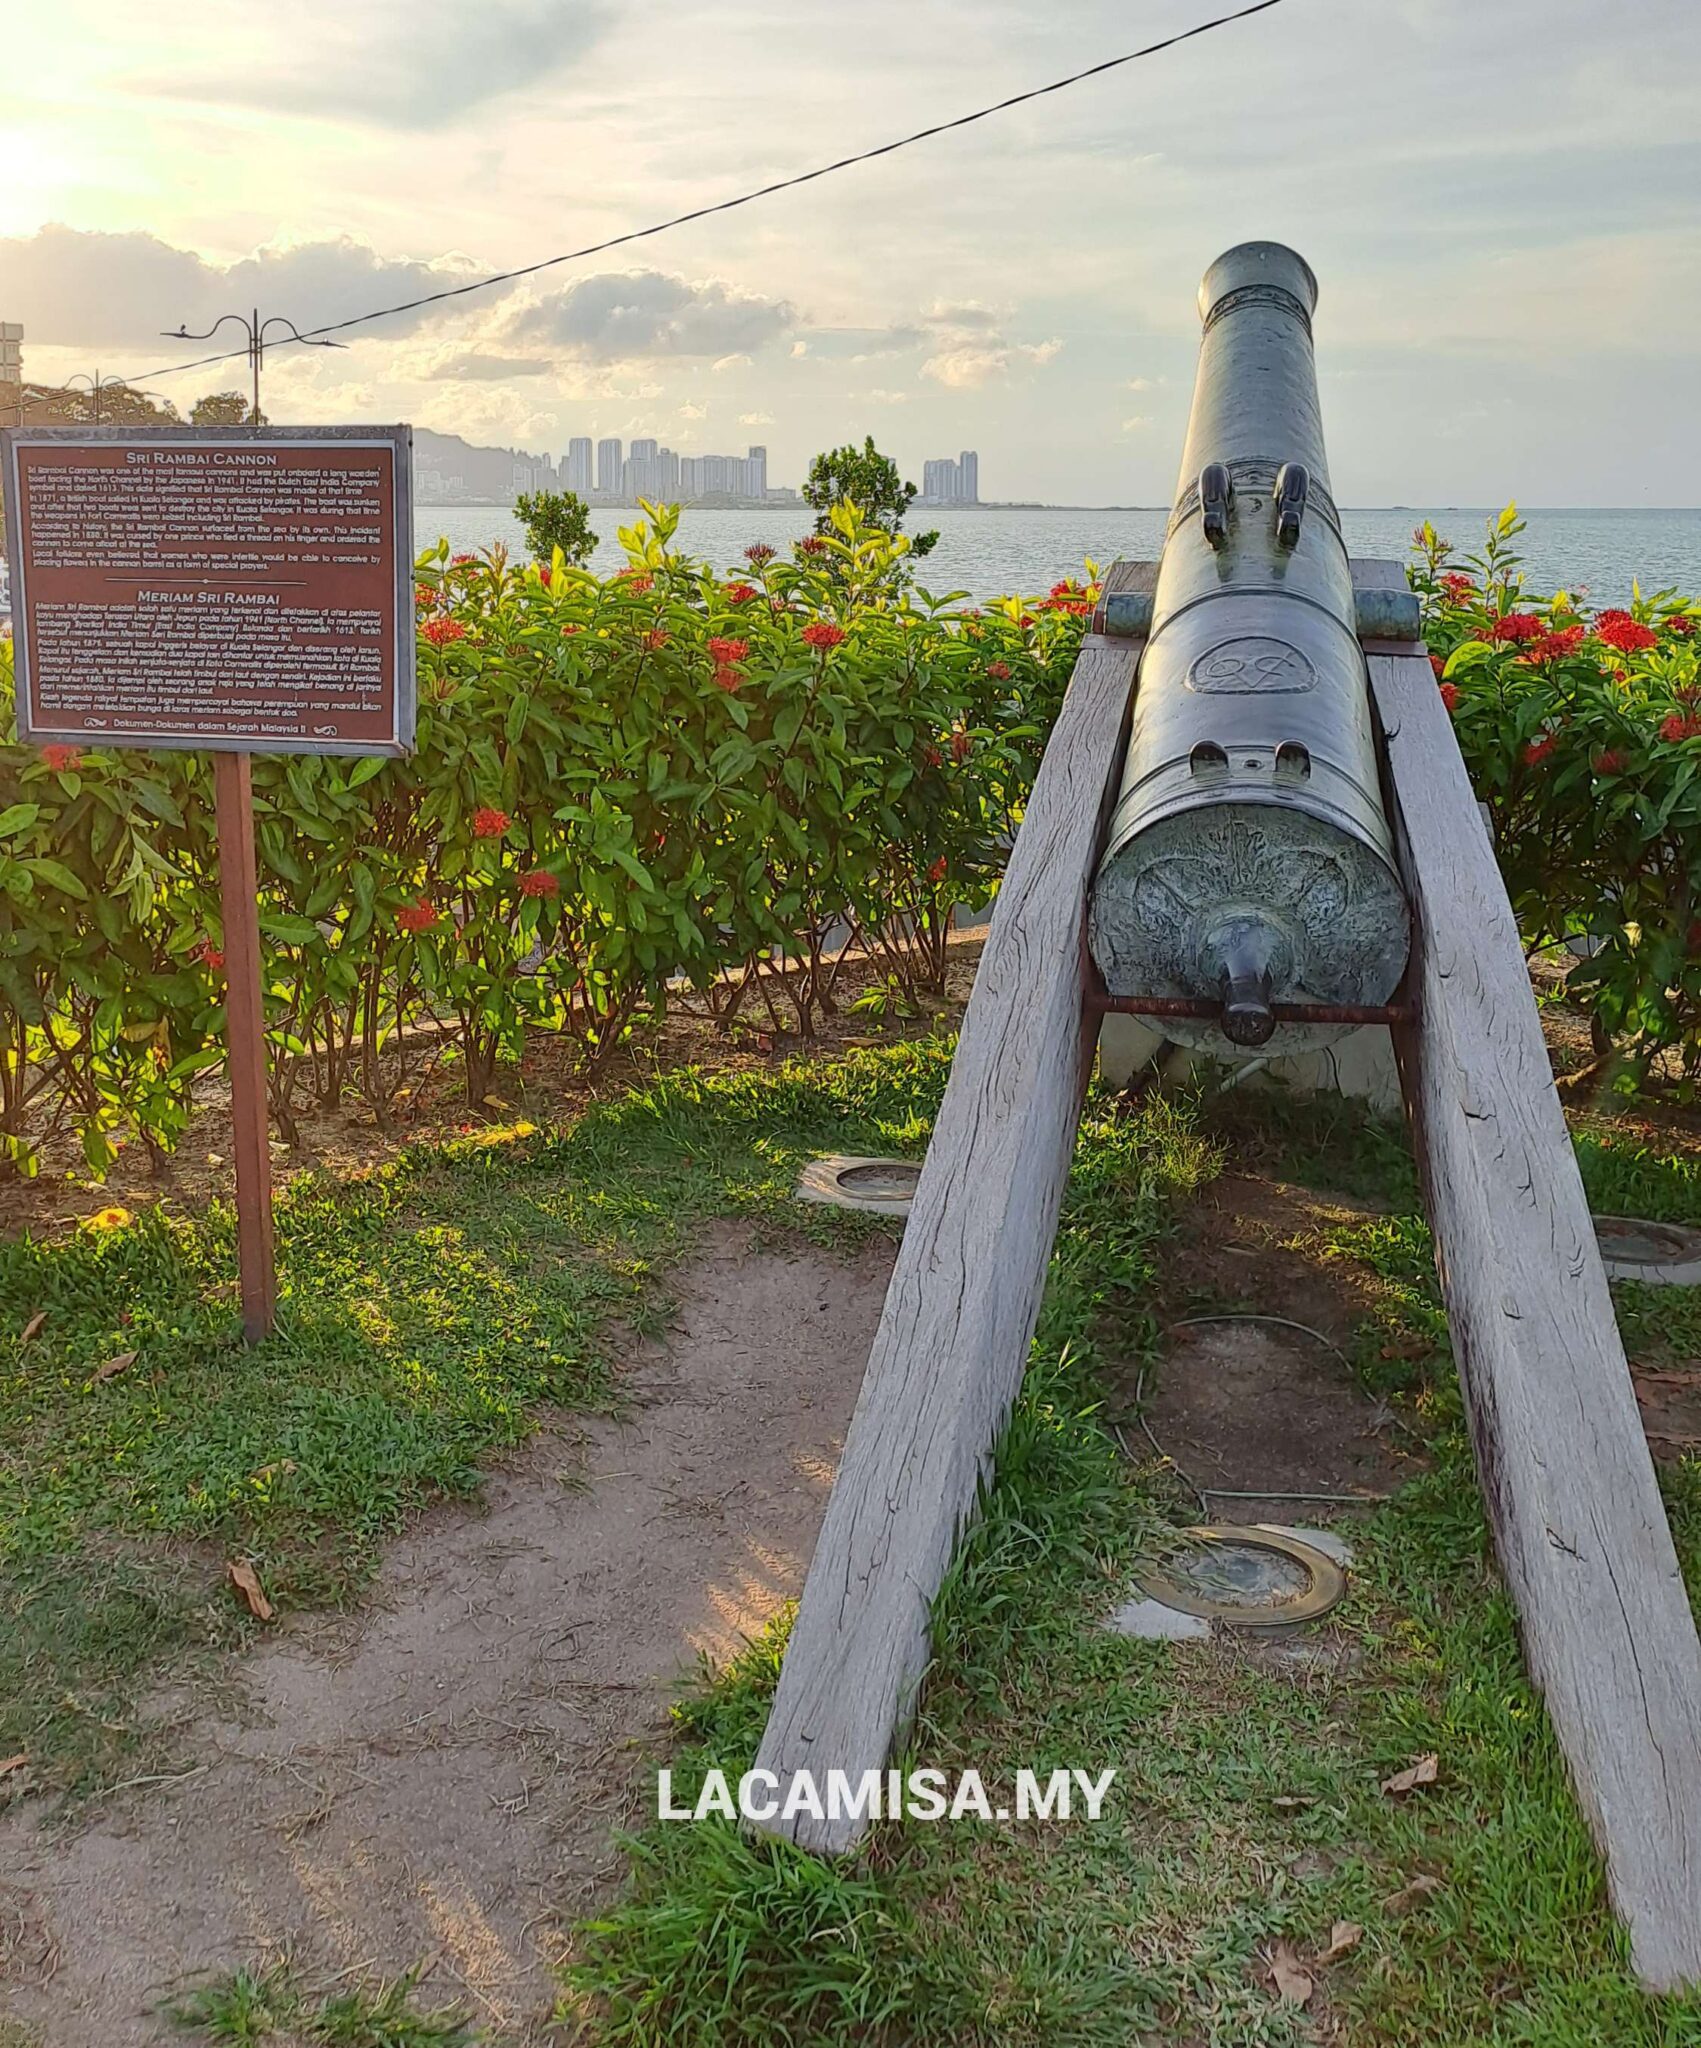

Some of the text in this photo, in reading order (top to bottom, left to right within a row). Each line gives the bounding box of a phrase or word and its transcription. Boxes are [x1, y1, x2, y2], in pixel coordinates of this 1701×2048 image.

[341, 477, 381, 487] Company
[113, 719, 195, 728] Dokumen-Dokumen
[197, 721, 224, 729] dalam
[227, 722, 258, 732] Sejarah
[261, 723, 298, 733] Malaysia
